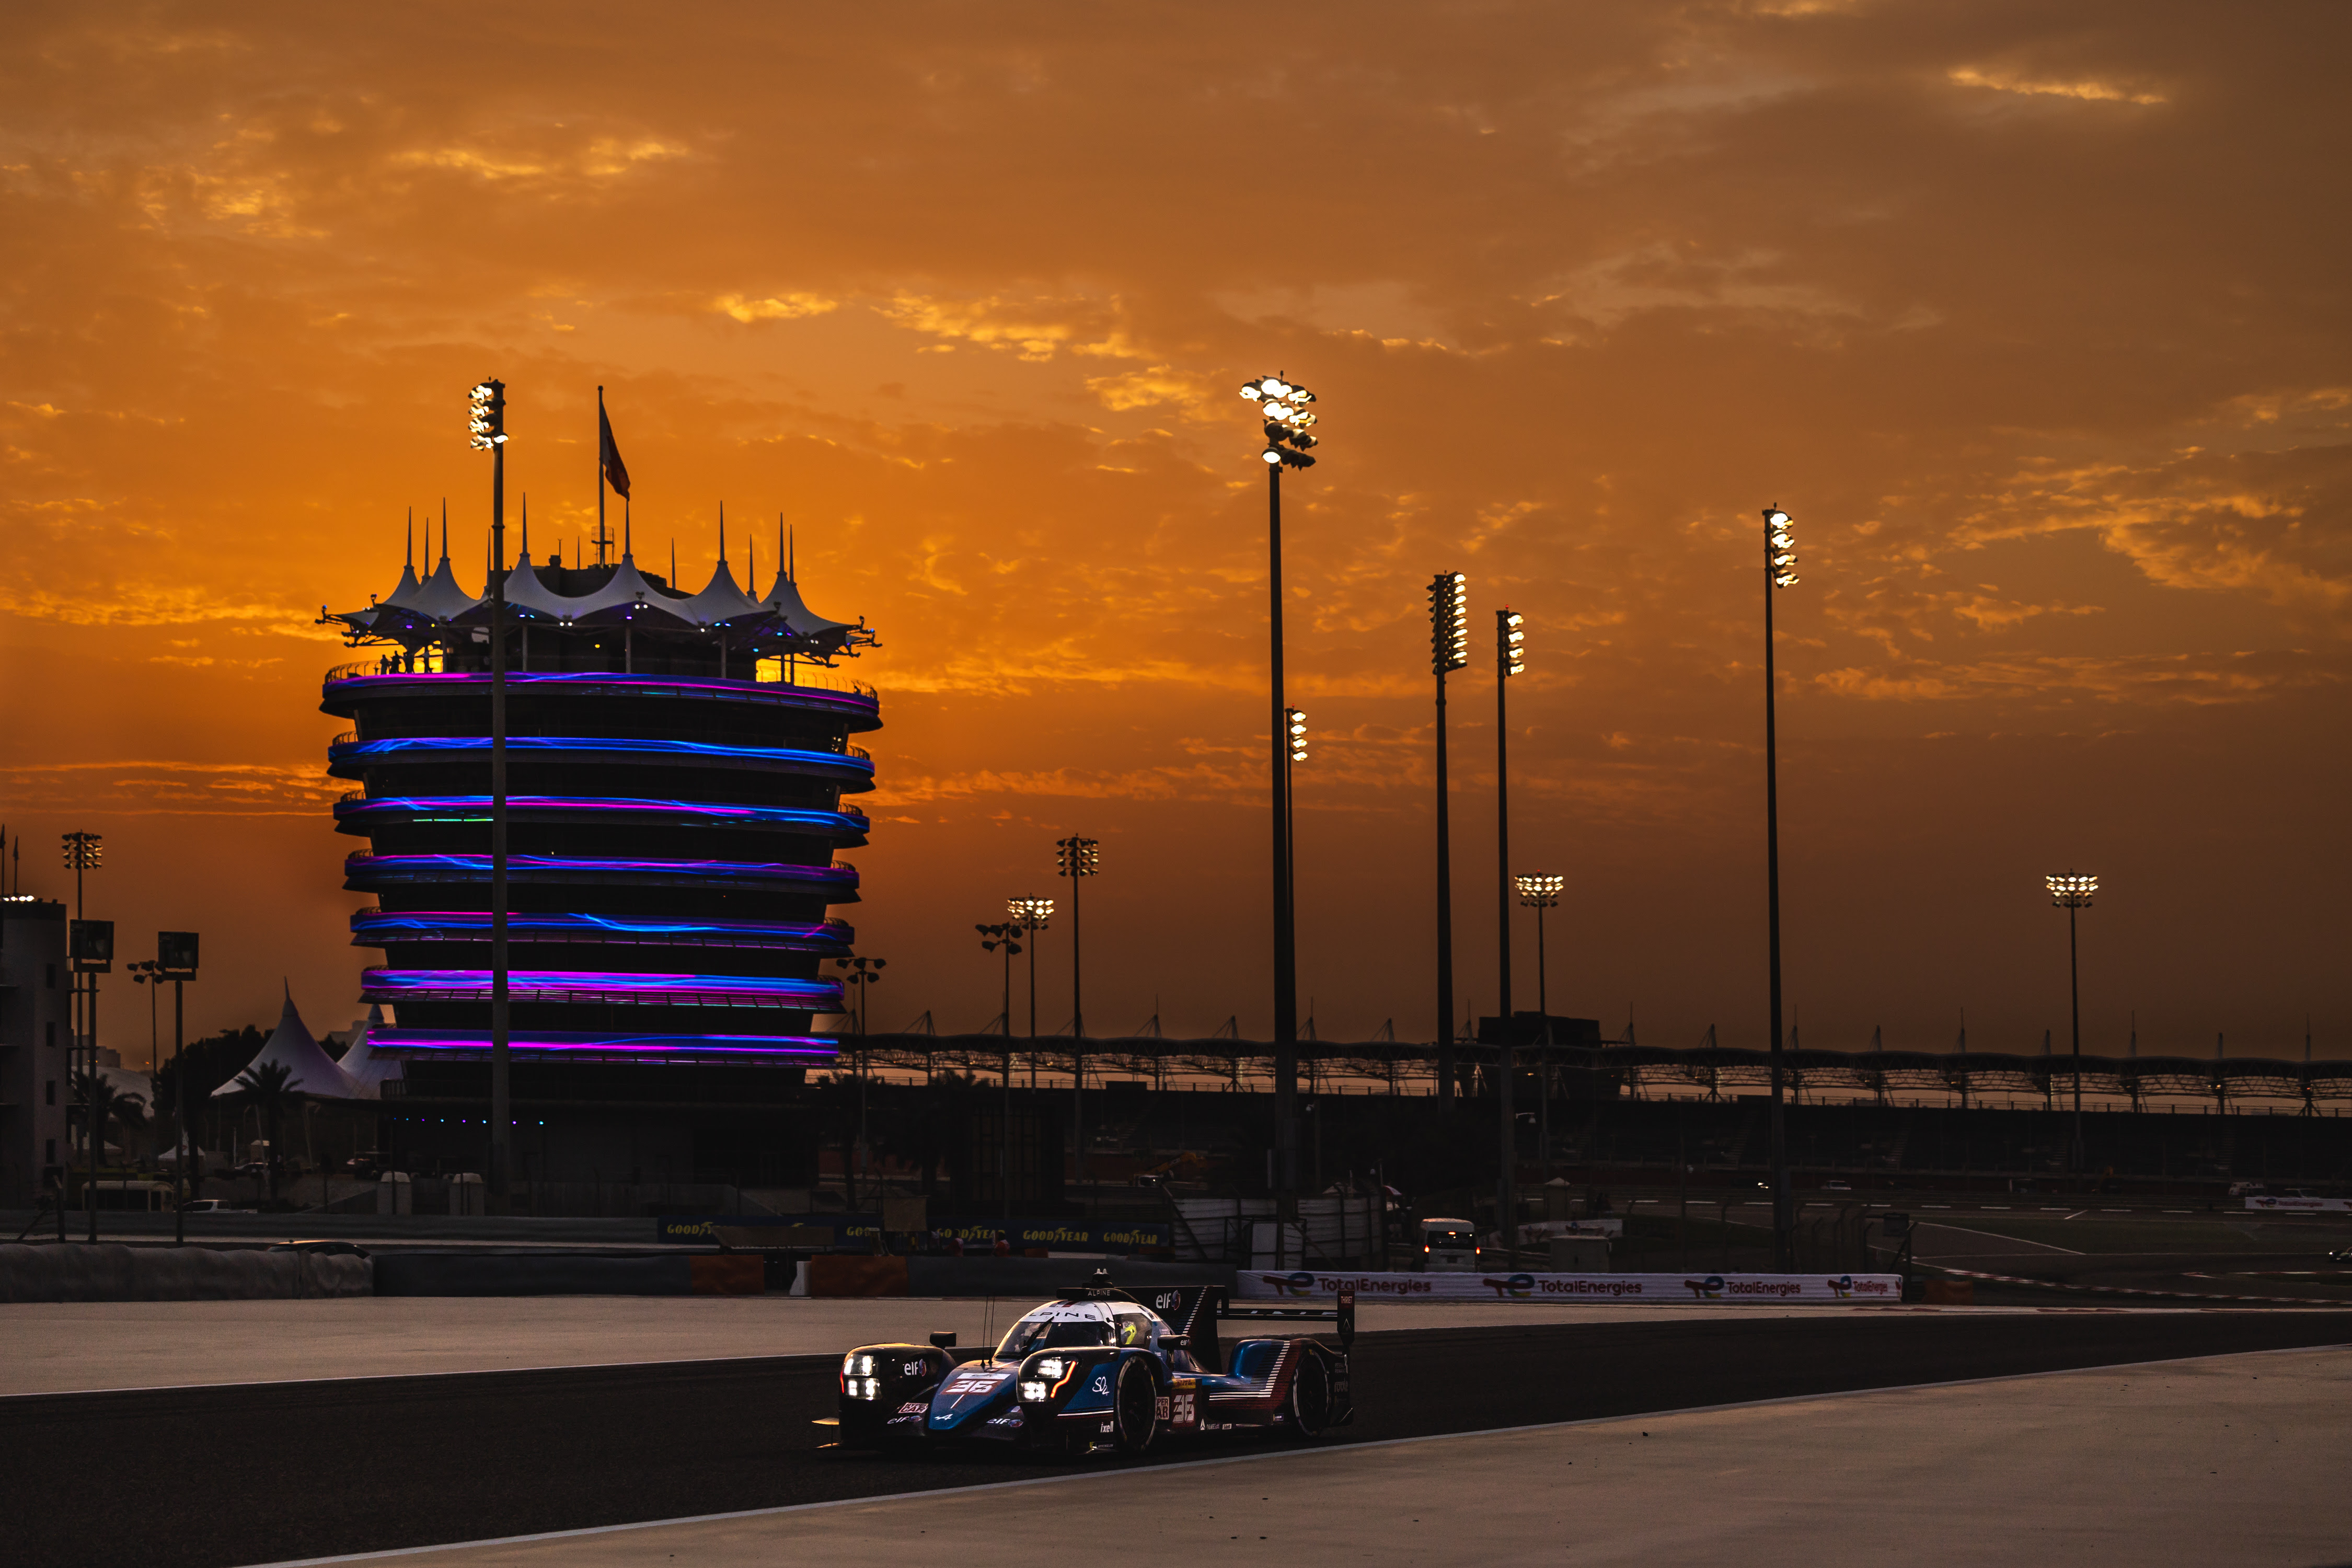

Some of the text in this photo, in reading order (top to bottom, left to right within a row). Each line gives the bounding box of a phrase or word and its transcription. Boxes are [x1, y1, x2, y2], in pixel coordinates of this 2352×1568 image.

[1023, 1228, 1089, 1244] GOODYEAR
[1103, 1230, 1157, 1246] GOODYEAR
[1318, 1278, 1431, 1295] TotalEnergies
[1538, 1280, 1642, 1296] TotalEnergies
[1726, 1281, 1801, 1296] TotalEnergies
[1156, 1293, 1171, 1309] elf
[1029, 1312, 1097, 1320] LPINE
[904, 1361, 918, 1376] elf
[946, 1380, 998, 1393] 36
[1157, 1406, 1168, 1418] AR
[1172, 1394, 1194, 1423] 36
[887, 1416, 909, 1424] elf
[1100, 1421, 1114, 1433] ixell
